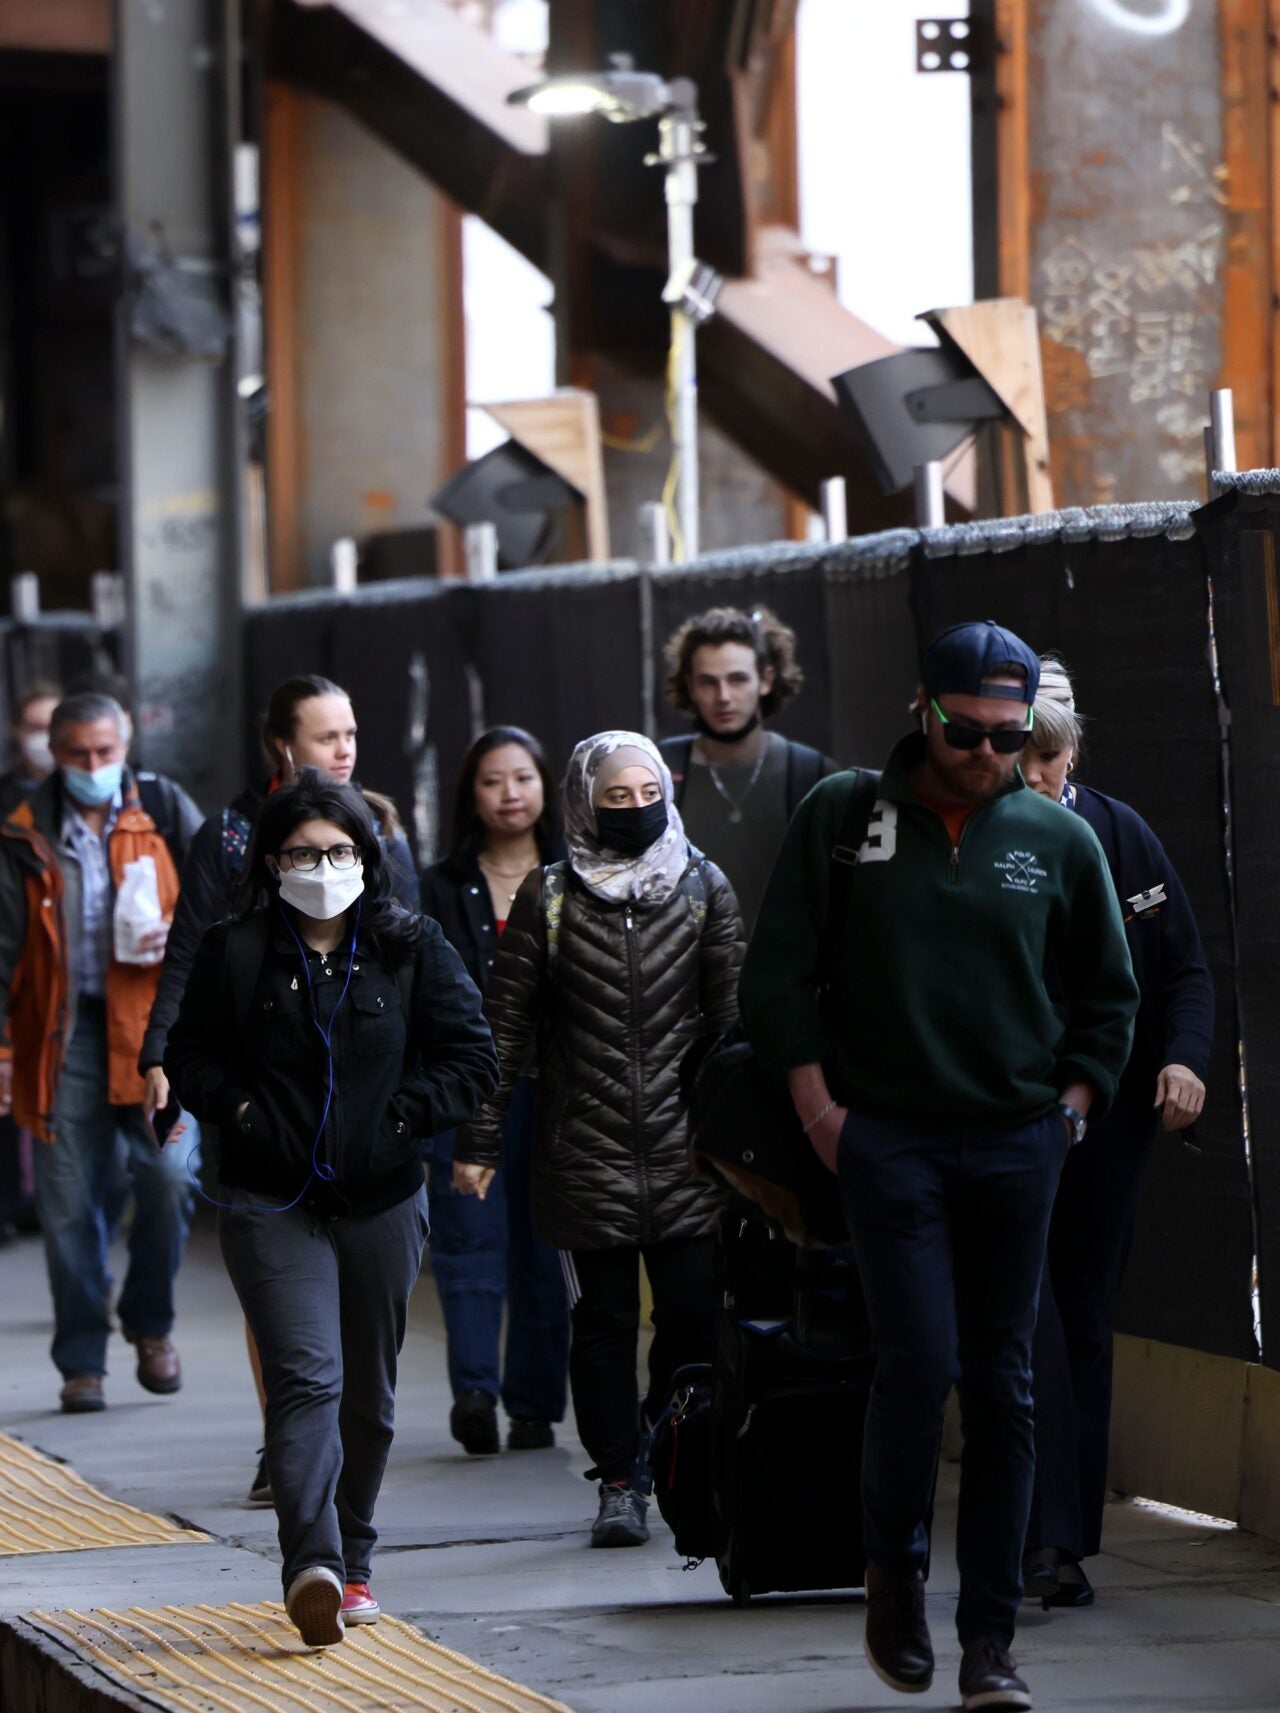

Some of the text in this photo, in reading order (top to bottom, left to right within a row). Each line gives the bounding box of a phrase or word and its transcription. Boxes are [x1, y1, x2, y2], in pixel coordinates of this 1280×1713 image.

[859, 799, 897, 863] 3
[1013, 850, 1031, 858] POLO
[1027, 866, 1047, 876] LAUREN
